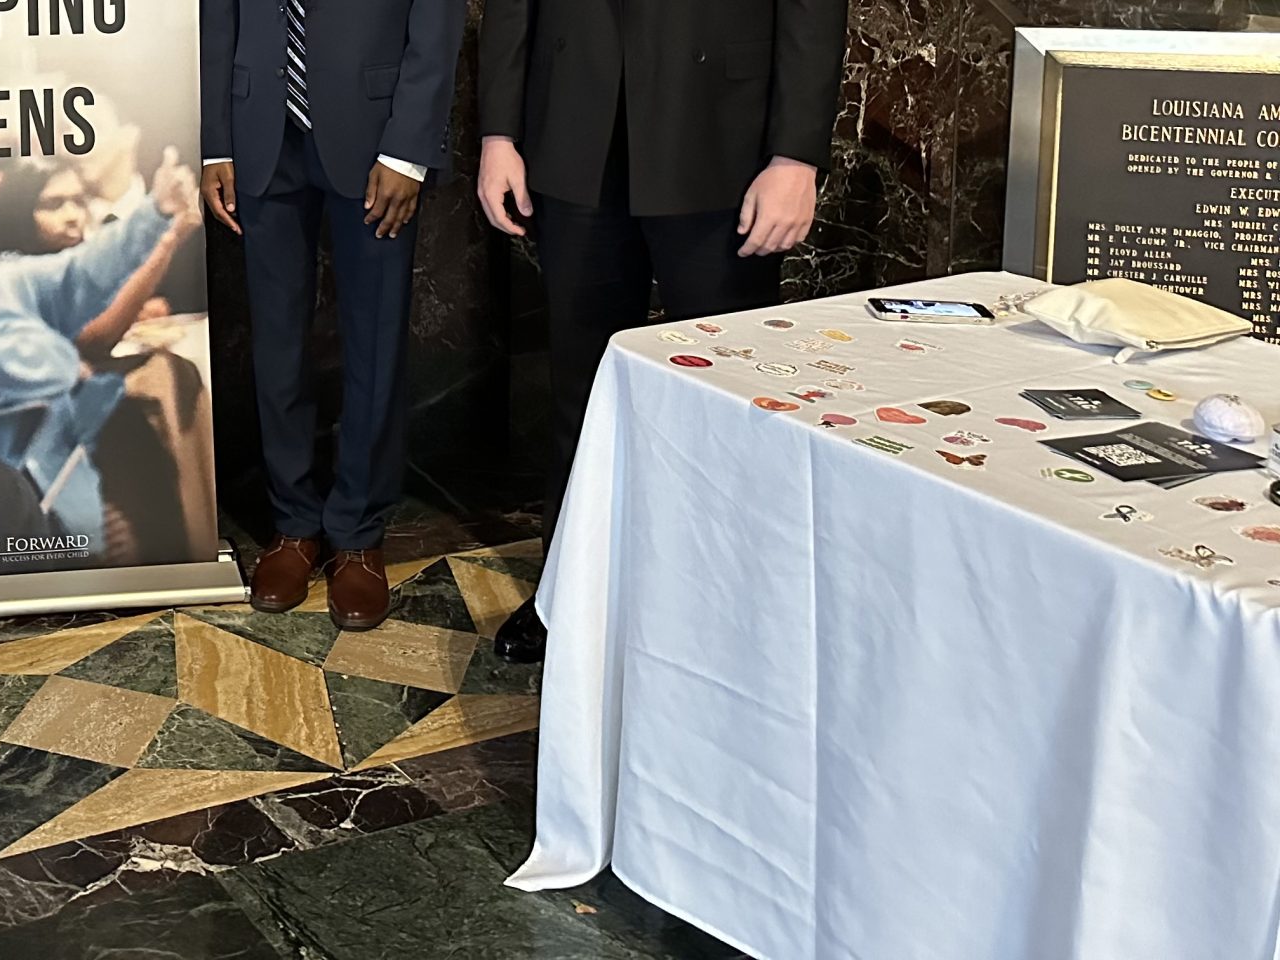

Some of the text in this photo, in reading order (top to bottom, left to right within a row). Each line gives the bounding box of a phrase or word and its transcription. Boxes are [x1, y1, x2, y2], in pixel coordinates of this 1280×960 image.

[1152, 99, 1245, 120] LOUISIANA
[1122, 124, 1280, 147] BICENTENNIAL CO
[1128, 154, 1279, 170] DEDICATED TO THE PEOPLE OF
[1127, 164, 1162, 174] OPENED
[1167, 167, 1179, 175] BY
[1186, 168, 1204, 177] THE
[1210, 169, 1259, 179] GOVERNOR
[1230, 187, 1280, 201] EXECUT
[1195, 203, 1231, 215] EDWIN
[1231, 221, 1266, 230] MURIEL
[1114, 224, 1142, 233] DOLLY
[1149, 227, 1167, 235] ANN
[1234, 232, 1274, 242] PROJECT
[1109, 247, 1138, 257] FLOYD
[1144, 250, 1172, 259] ALLEN
[1204, 241, 1225, 250] VICE
[1231, 243, 1280, 254] CHAIRMAN
[1109, 258, 1125, 267] JAY
[1131, 260, 1182, 271] BROUSSARD
[1107, 270, 1145, 279] CHESTER
[1164, 274, 1208, 284] CARVILLE
[6, 534, 89, 552] FORWARD
[2, 555, 30, 563] SUCCESS
[46, 552, 66, 560] EVERY
[66, 551, 90, 559] CHILD
